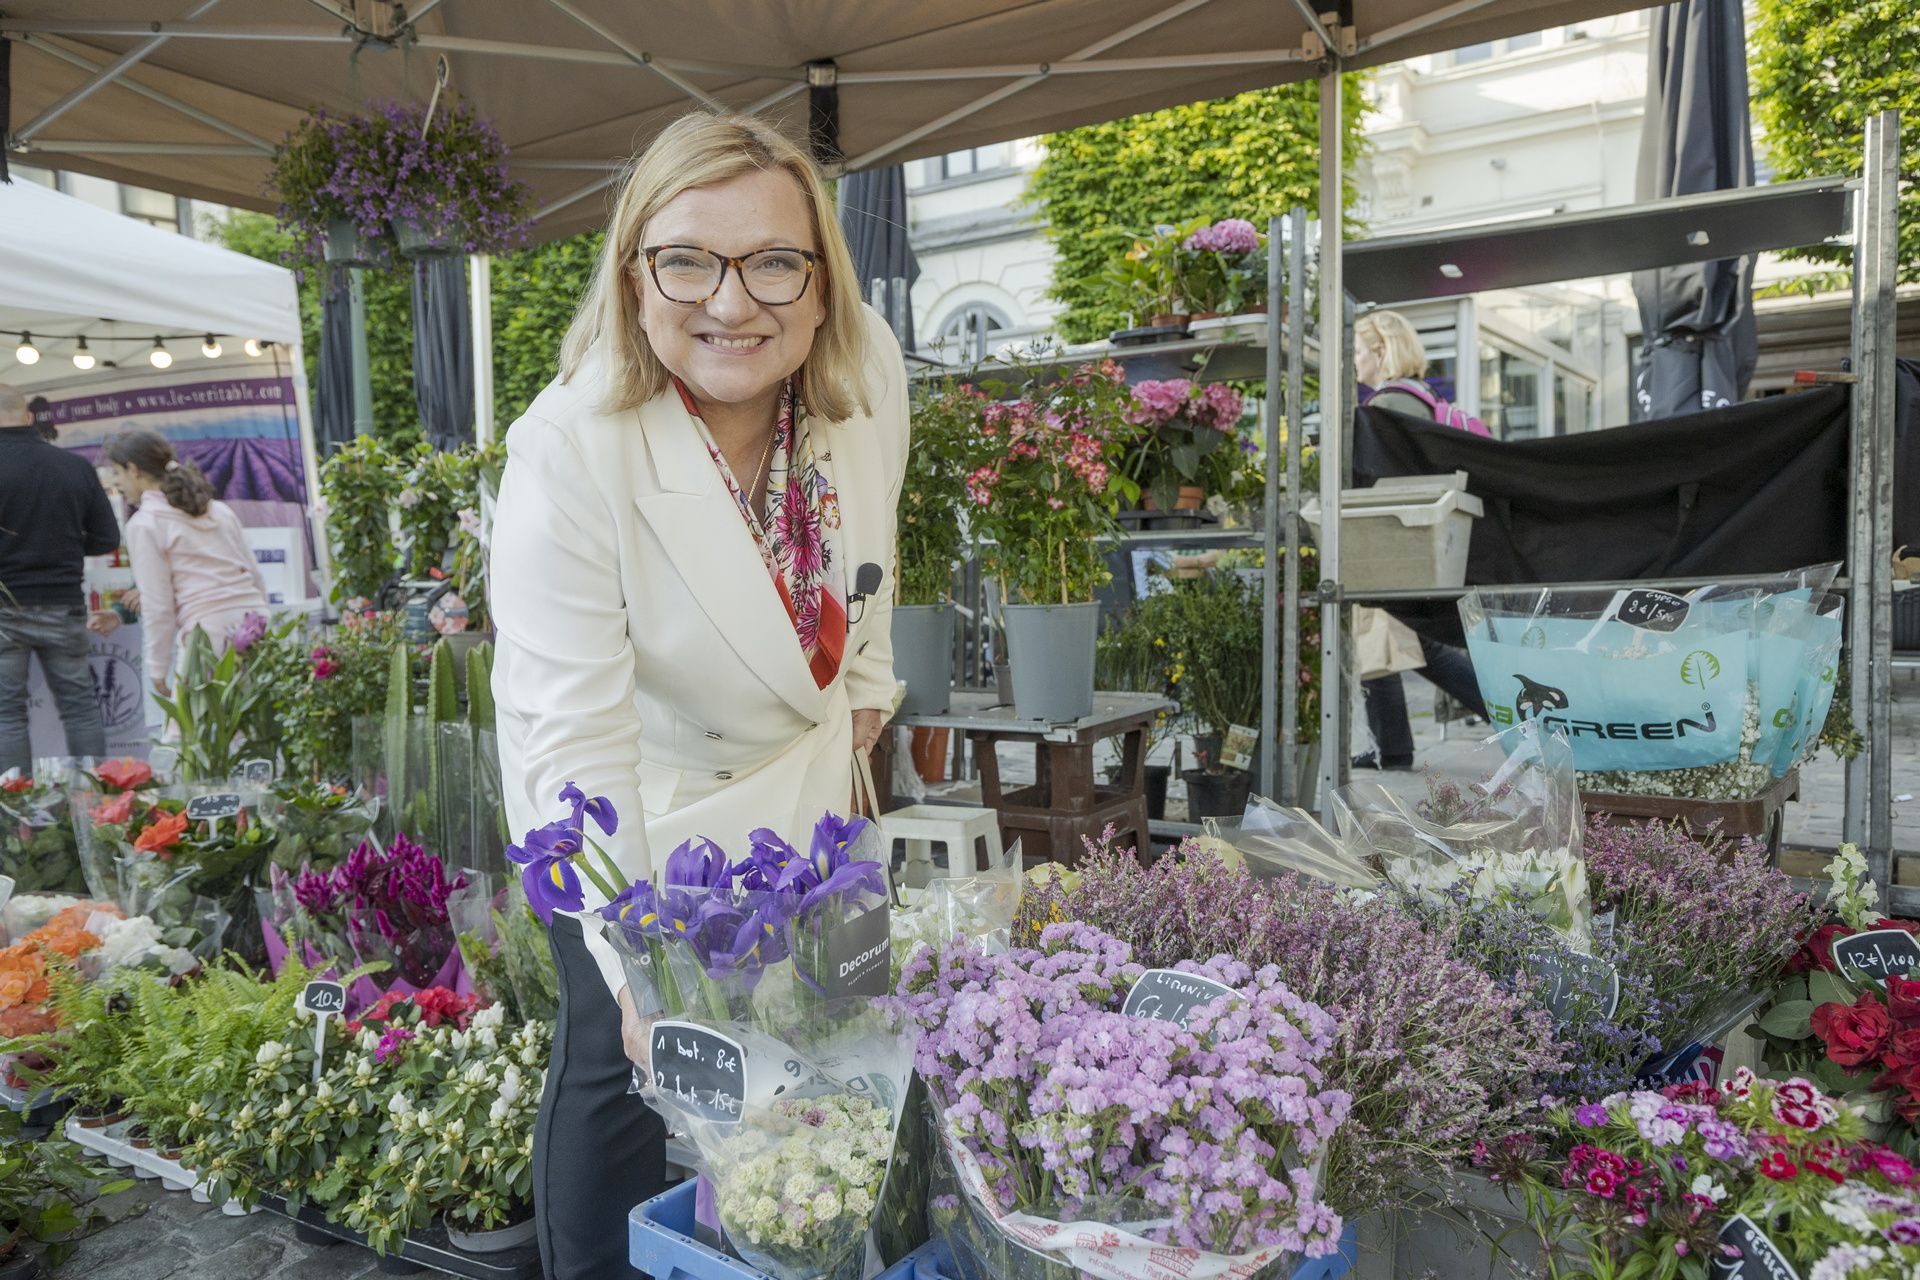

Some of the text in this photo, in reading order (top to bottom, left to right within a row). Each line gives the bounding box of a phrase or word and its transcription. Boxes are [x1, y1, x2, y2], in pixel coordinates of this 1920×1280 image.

[839, 936, 889, 978] Decorum
[657, 1034, 737, 1073] 1 bot. 8€
[675, 1074, 701, 1107] bot.
[708, 1088, 737, 1115] 15€
